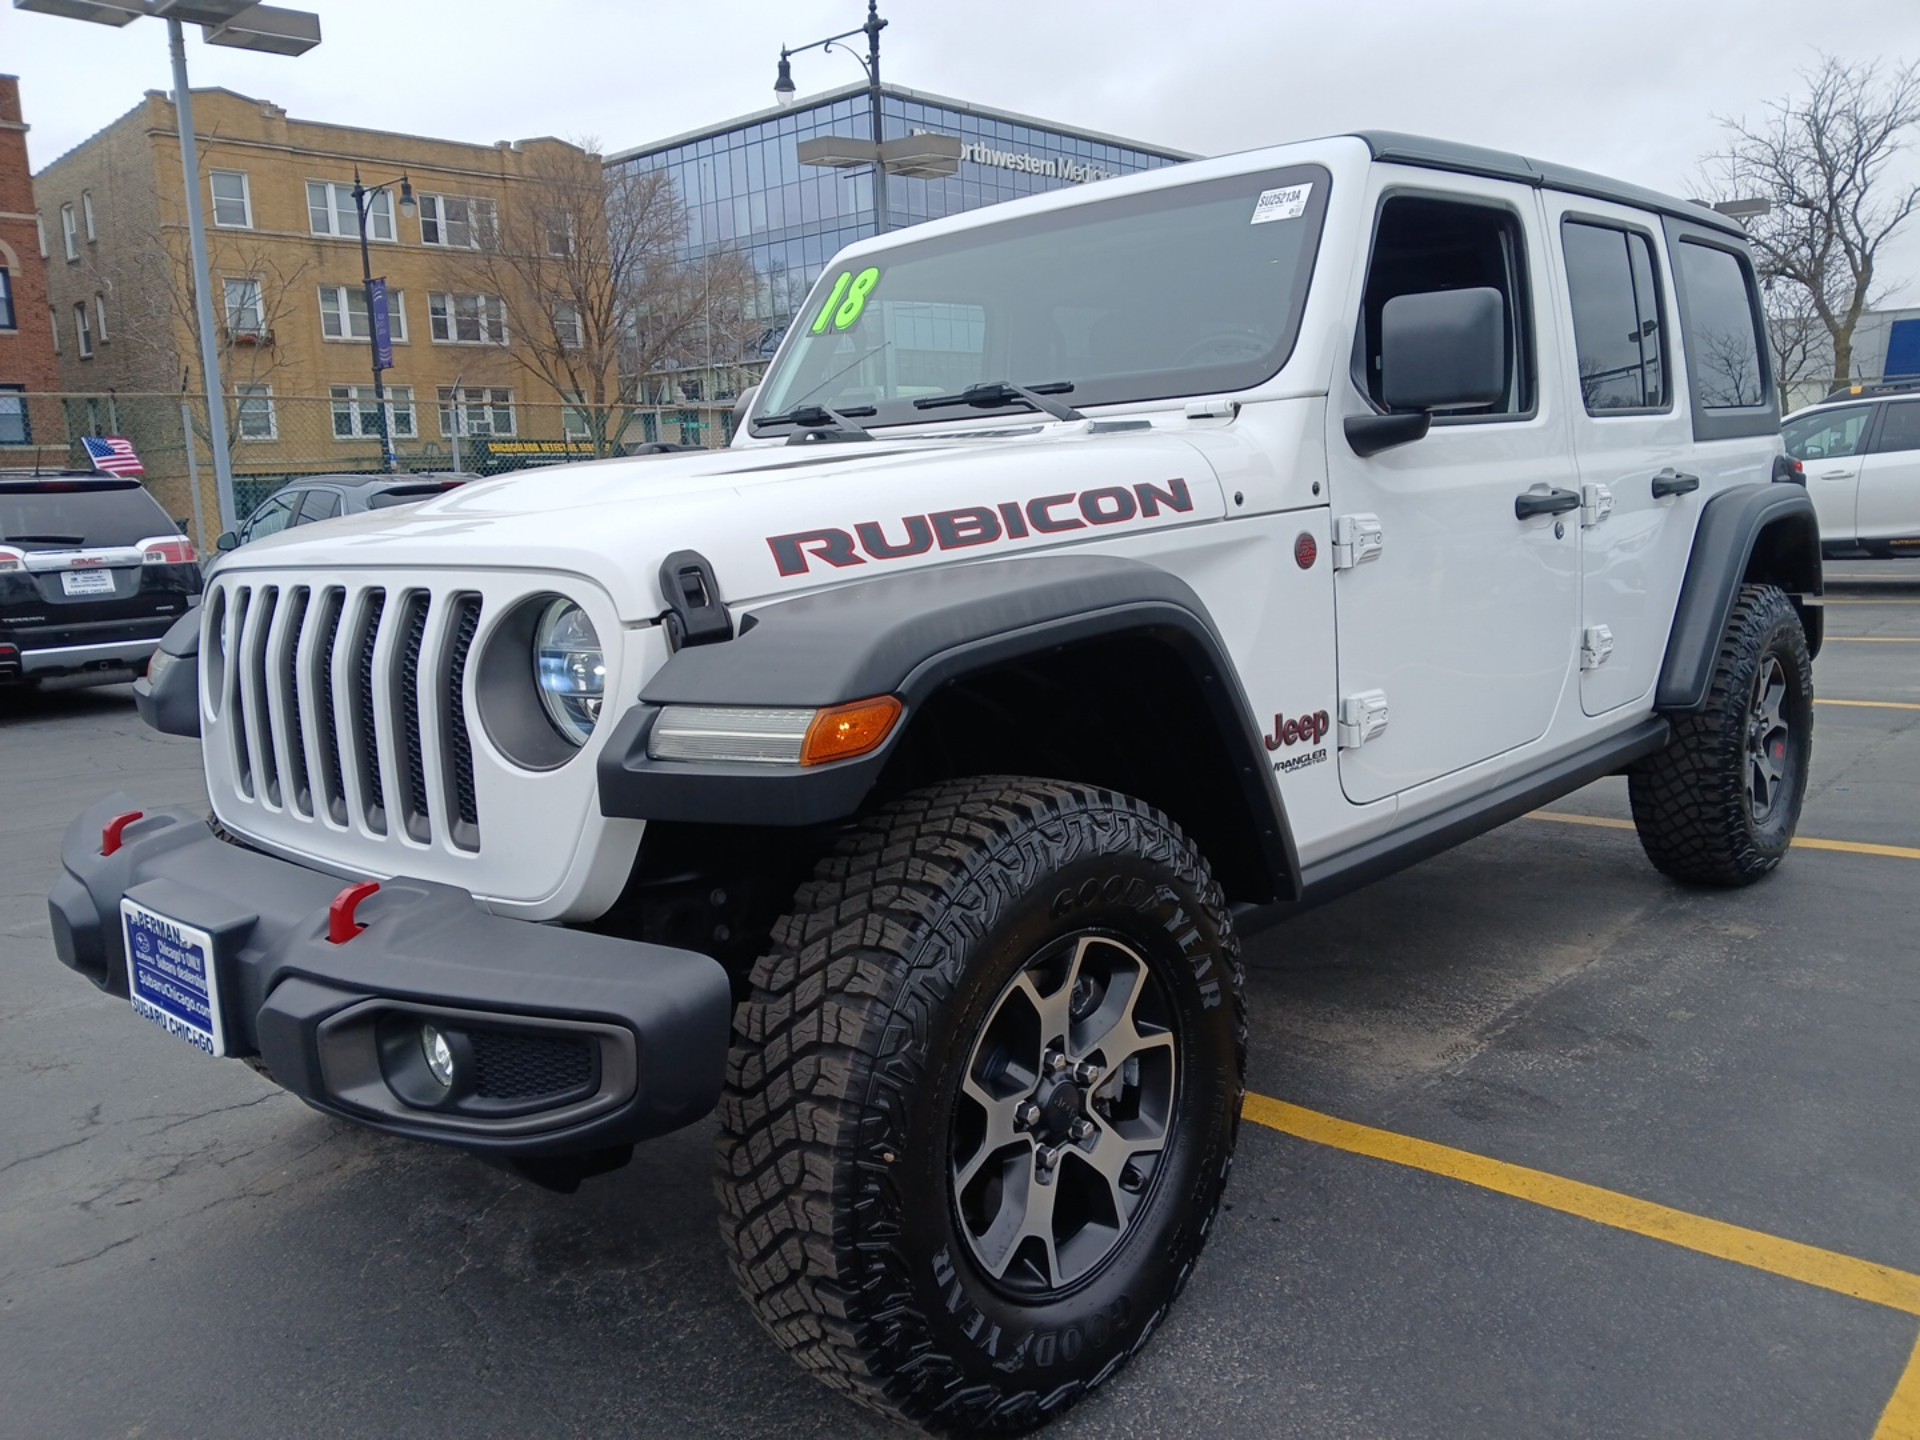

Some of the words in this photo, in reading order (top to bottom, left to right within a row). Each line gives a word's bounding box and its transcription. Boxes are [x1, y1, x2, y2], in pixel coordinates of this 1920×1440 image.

[960, 141, 1055, 176] orthwestern
[812, 266, 880, 335] 18
[766, 478, 1194, 577] RUBICON
[71, 557, 103, 566] GMC
[1264, 709, 1330, 751] Jeep
[132, 995, 167, 1030] SUBARU
[169, 1017, 214, 1056] CHICAGO
